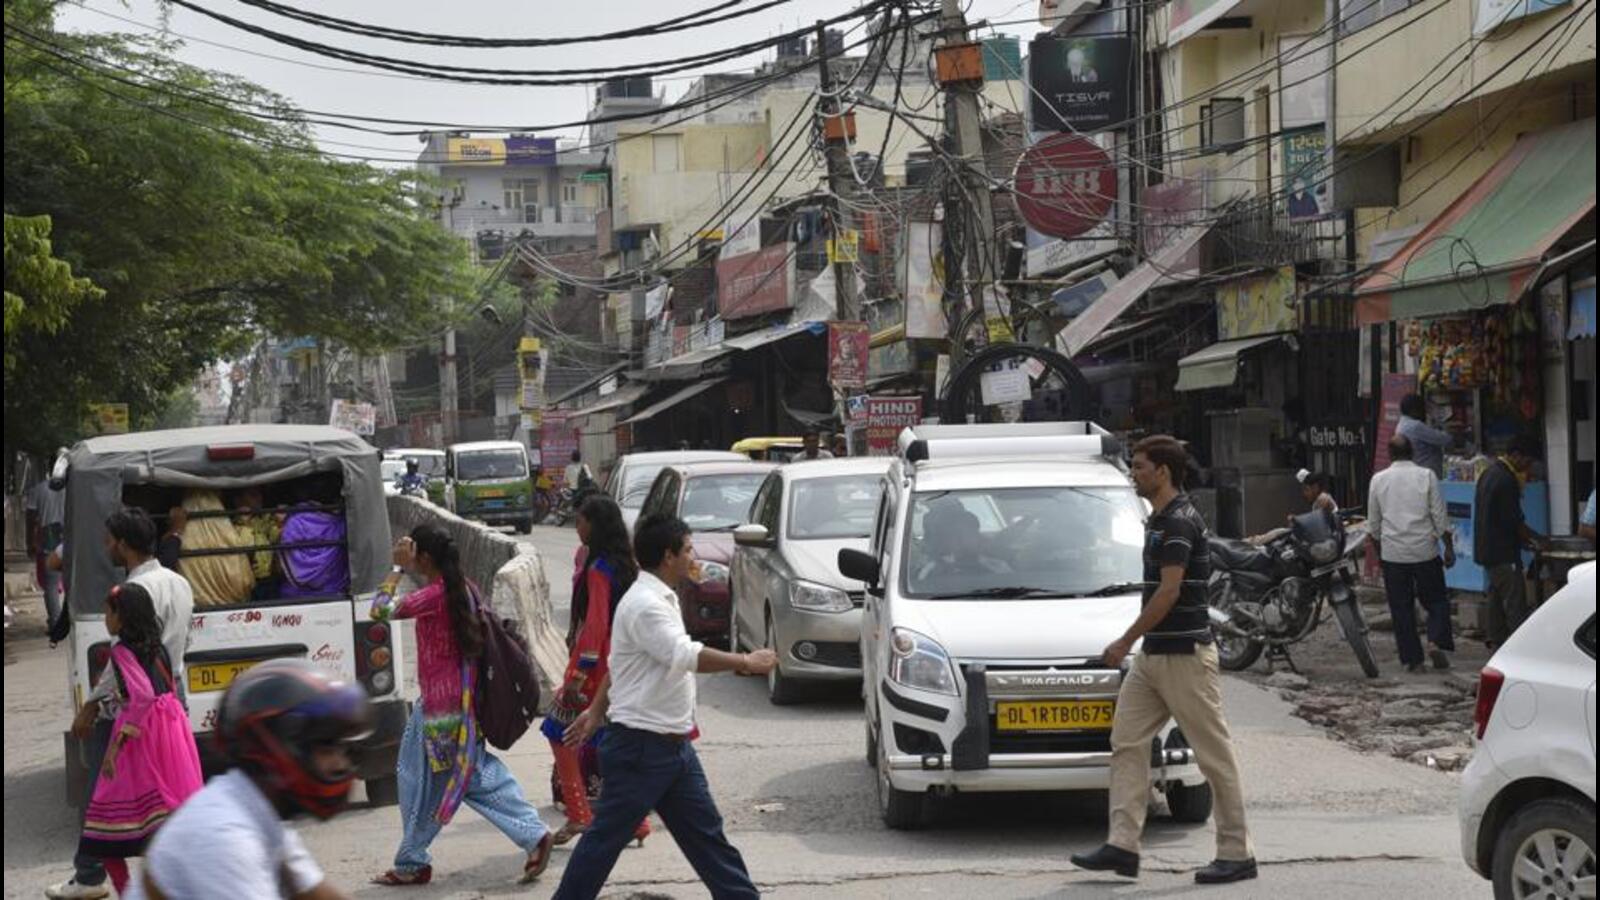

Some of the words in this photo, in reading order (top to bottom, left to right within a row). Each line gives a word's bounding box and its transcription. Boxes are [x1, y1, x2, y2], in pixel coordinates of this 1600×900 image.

[870, 402, 917, 414] HIND
[868, 414, 919, 427] PHOTOSTAT
[1310, 425, 1336, 446] Gate
[1008, 705, 1112, 724] DL1RTB0675
